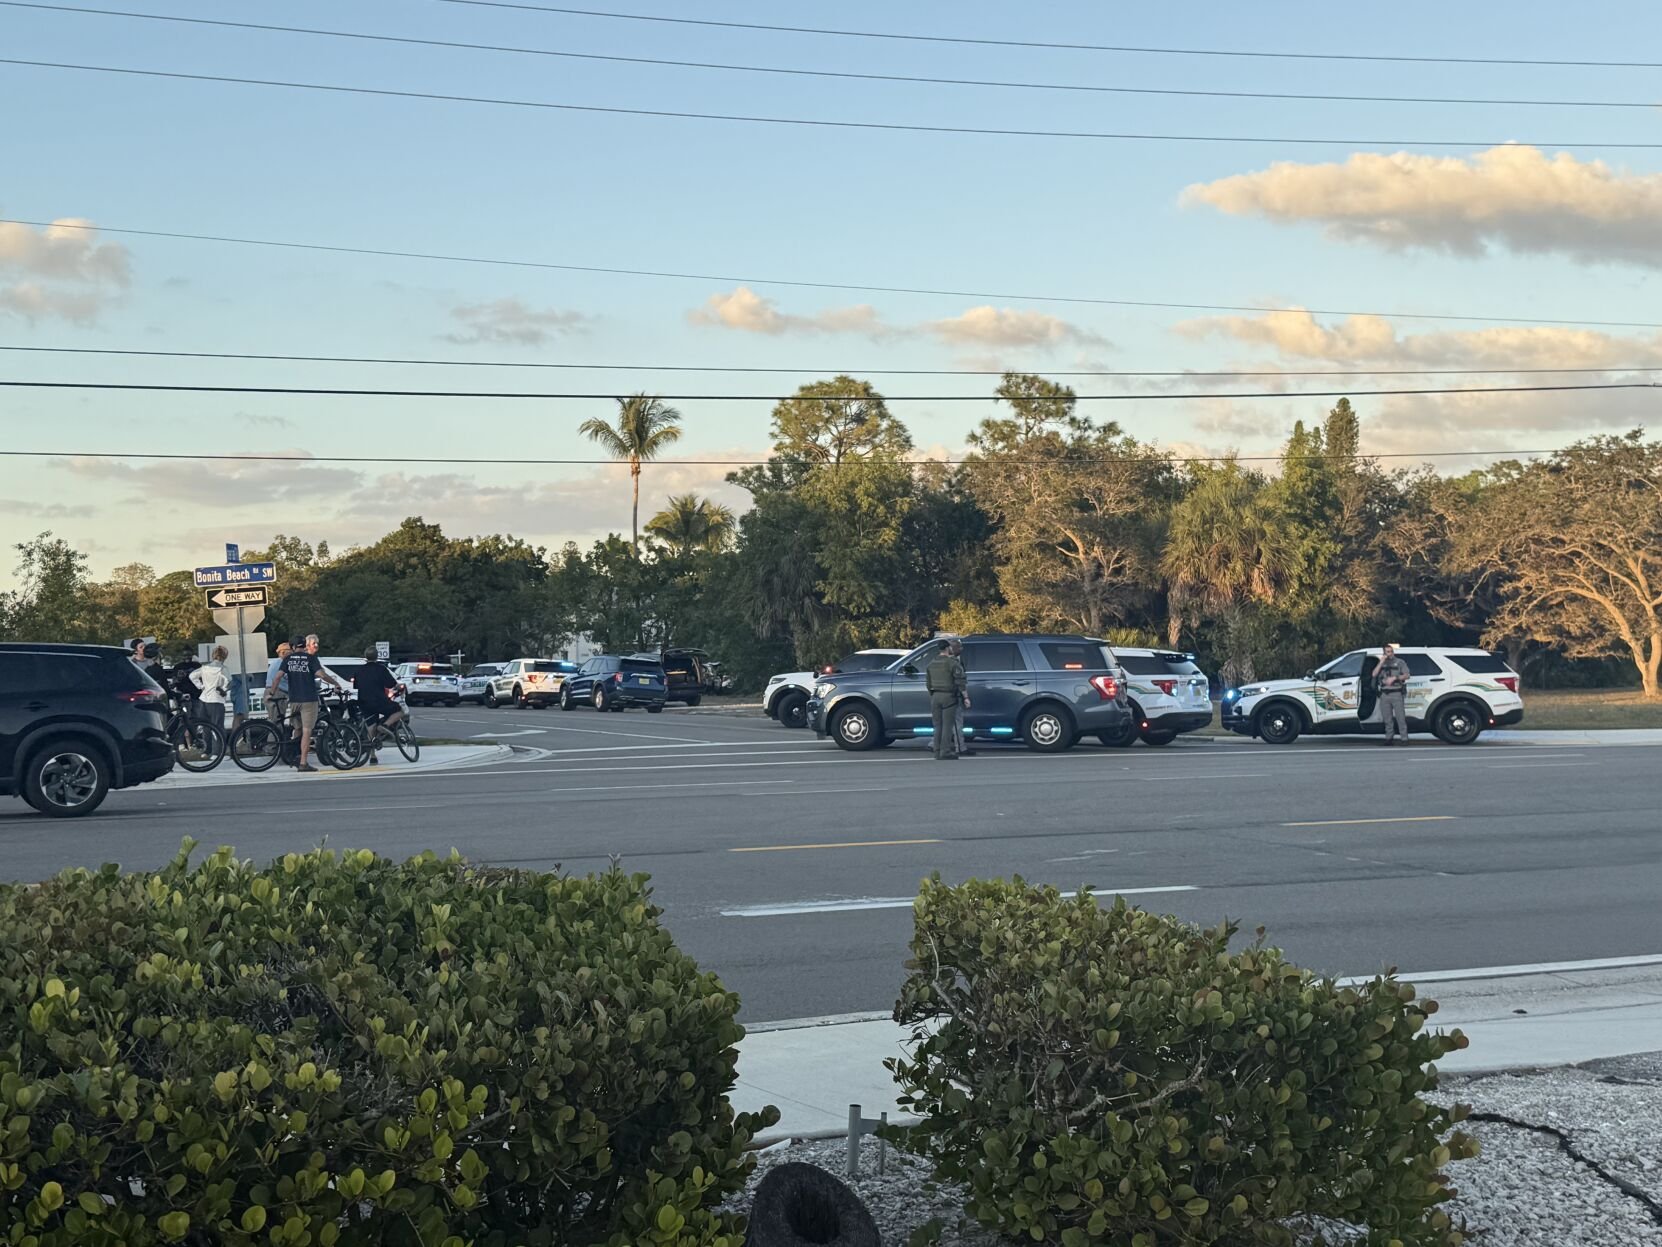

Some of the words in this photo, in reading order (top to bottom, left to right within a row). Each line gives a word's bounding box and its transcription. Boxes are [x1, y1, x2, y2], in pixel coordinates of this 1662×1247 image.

[197, 571, 222, 582] Bonita
[226, 568, 250, 581] Beach
[262, 567, 273, 577] SW
[244, 592, 261, 600] WAY
